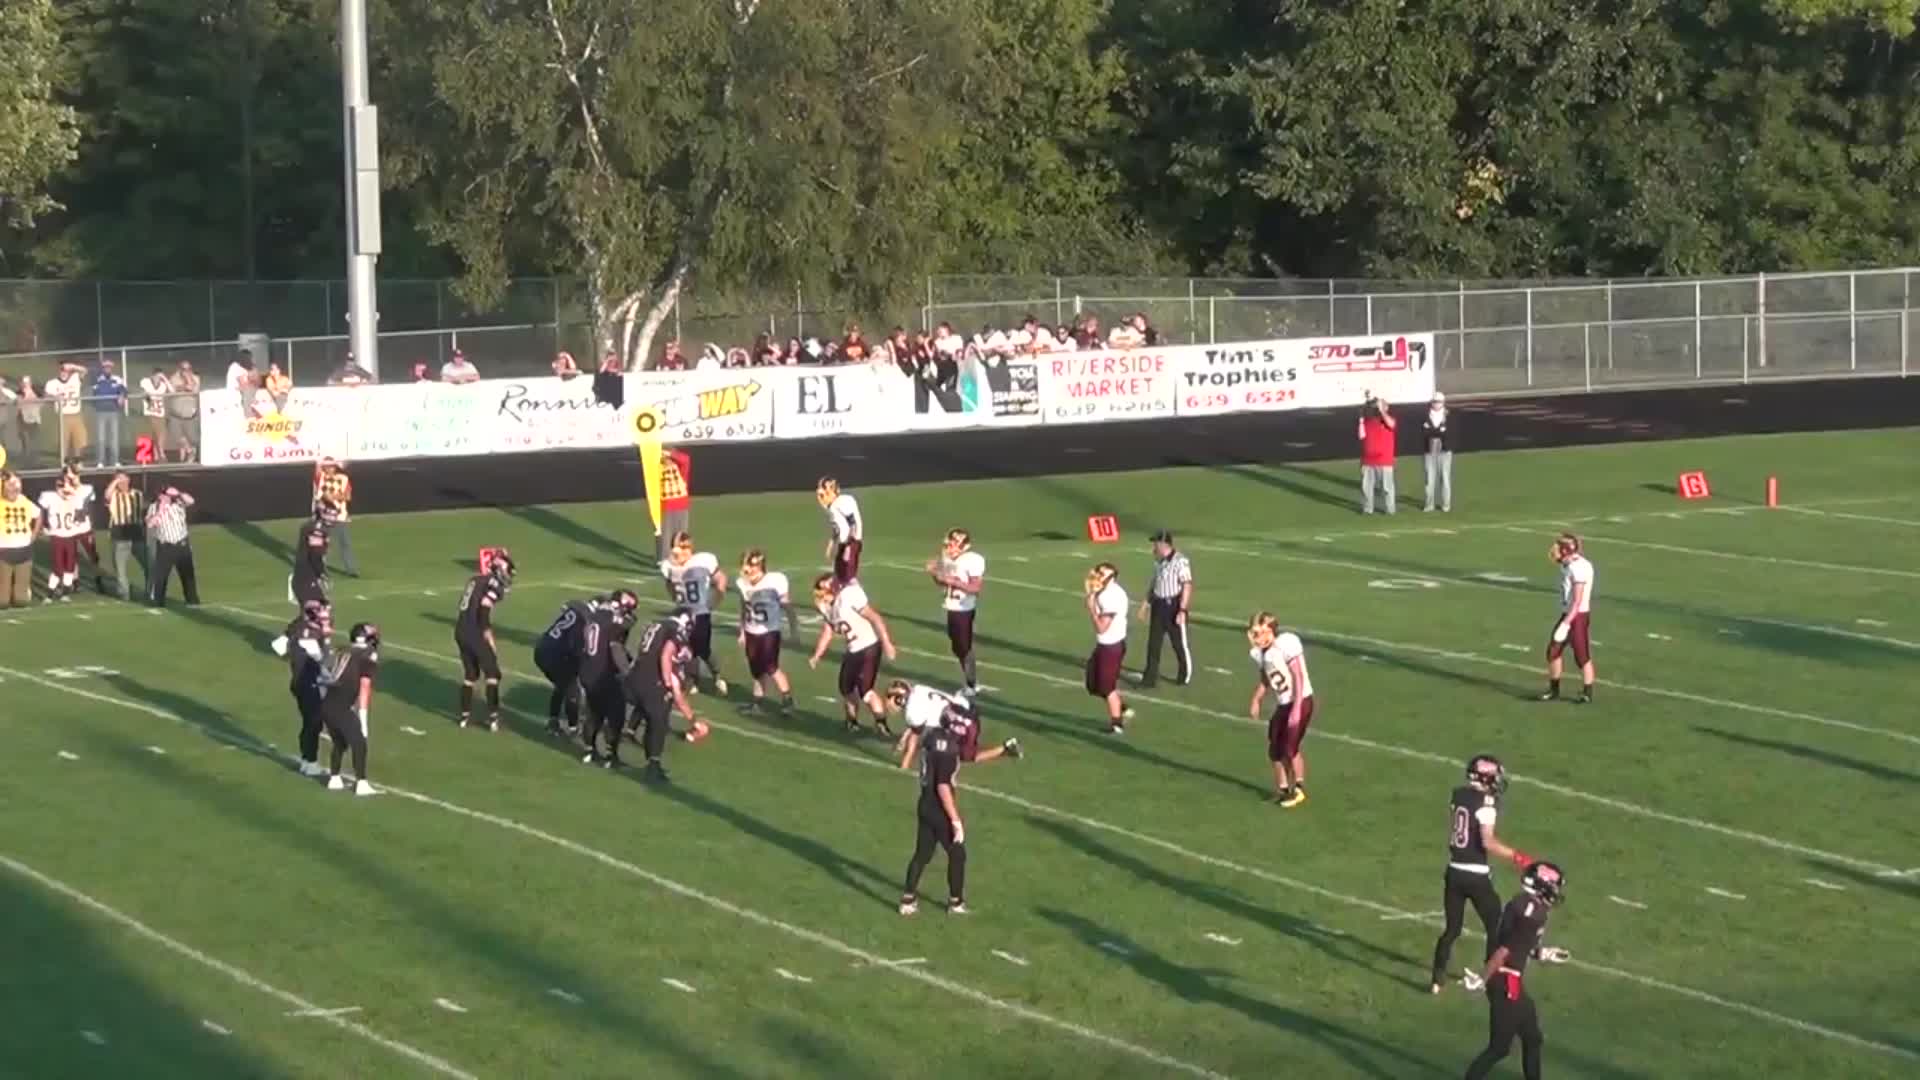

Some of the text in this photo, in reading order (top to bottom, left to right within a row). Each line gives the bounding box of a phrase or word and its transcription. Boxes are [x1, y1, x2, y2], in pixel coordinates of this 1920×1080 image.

[1052, 355, 1165, 376] RIVERSIDE
[1205, 347, 1275, 365] Tim's
[1183, 367, 1297, 387] Trophies
[797, 375, 853, 414] EL
[1067, 378, 1152, 398] MARKET
[246, 420, 303, 434] SUNOCO
[229, 446, 254, 461] Go
[1094, 518, 1114, 538] 10
